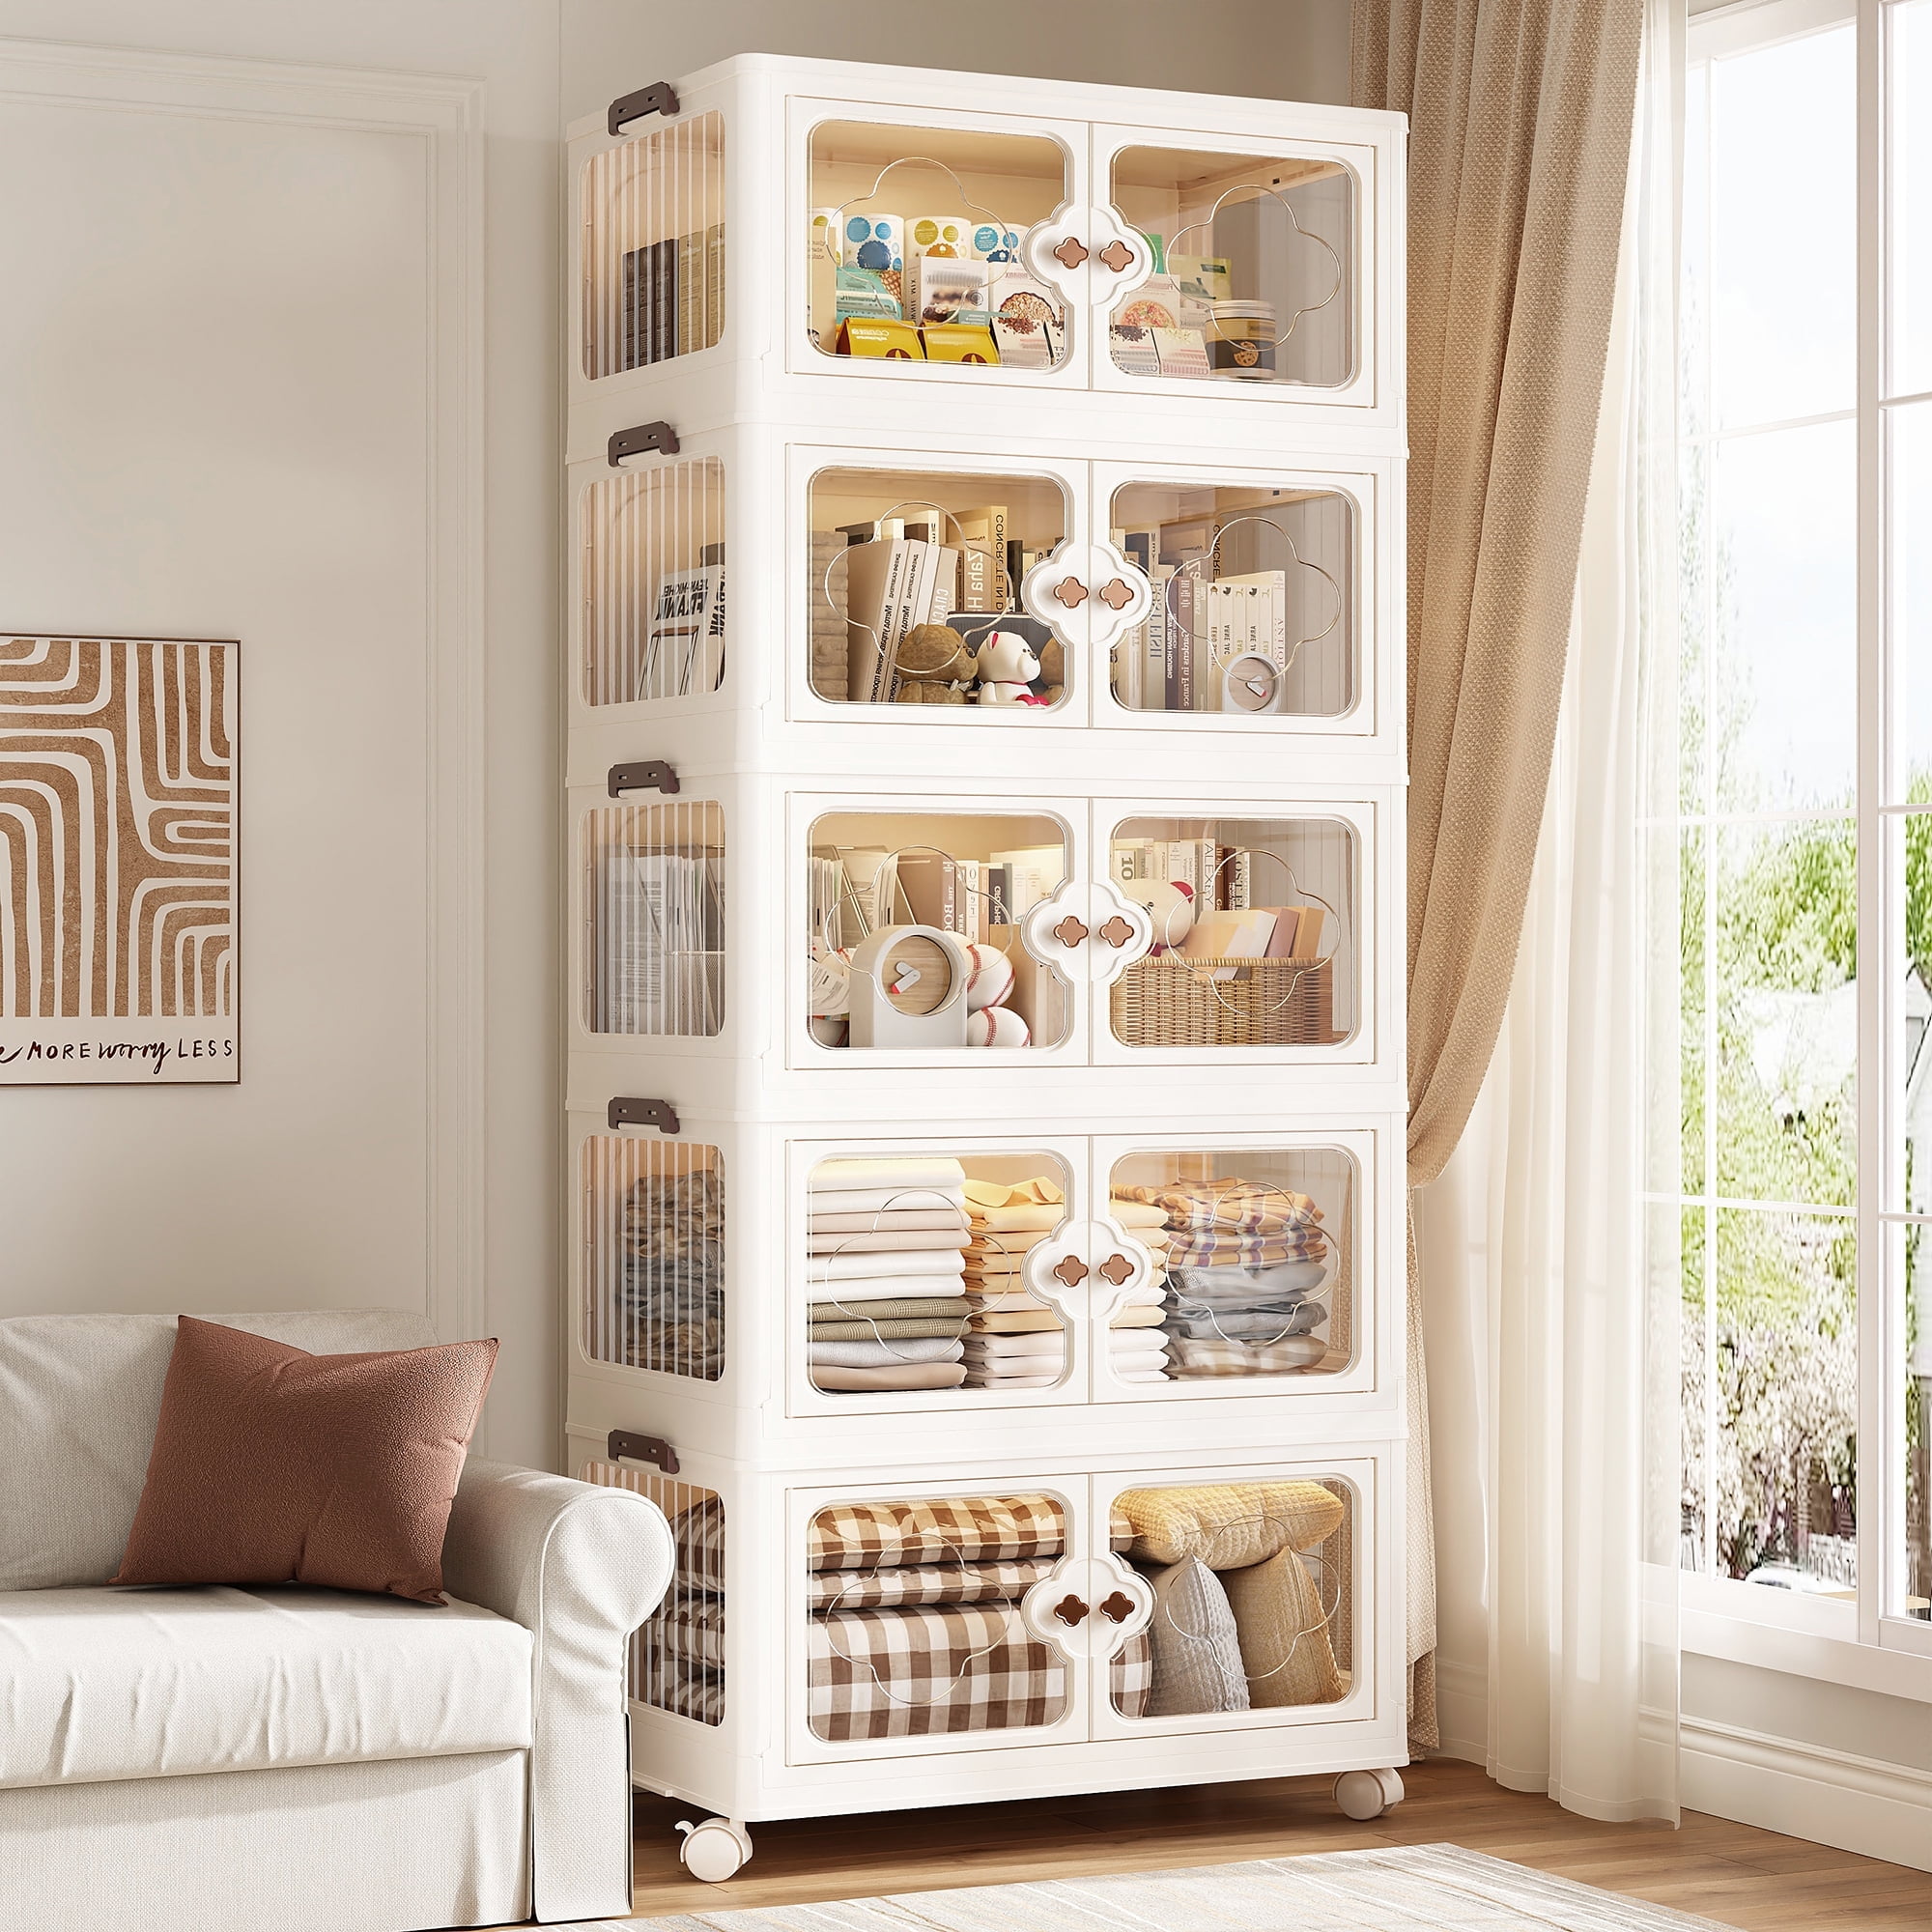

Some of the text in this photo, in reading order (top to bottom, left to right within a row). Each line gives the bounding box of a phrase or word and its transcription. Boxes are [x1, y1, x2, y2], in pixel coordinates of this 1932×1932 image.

[1122, 857, 1133, 880] 10
[27, 1040, 91, 1060] MORE
[99, 1041, 171, 1074] worry
[178, 1038, 233, 1058] LESS
